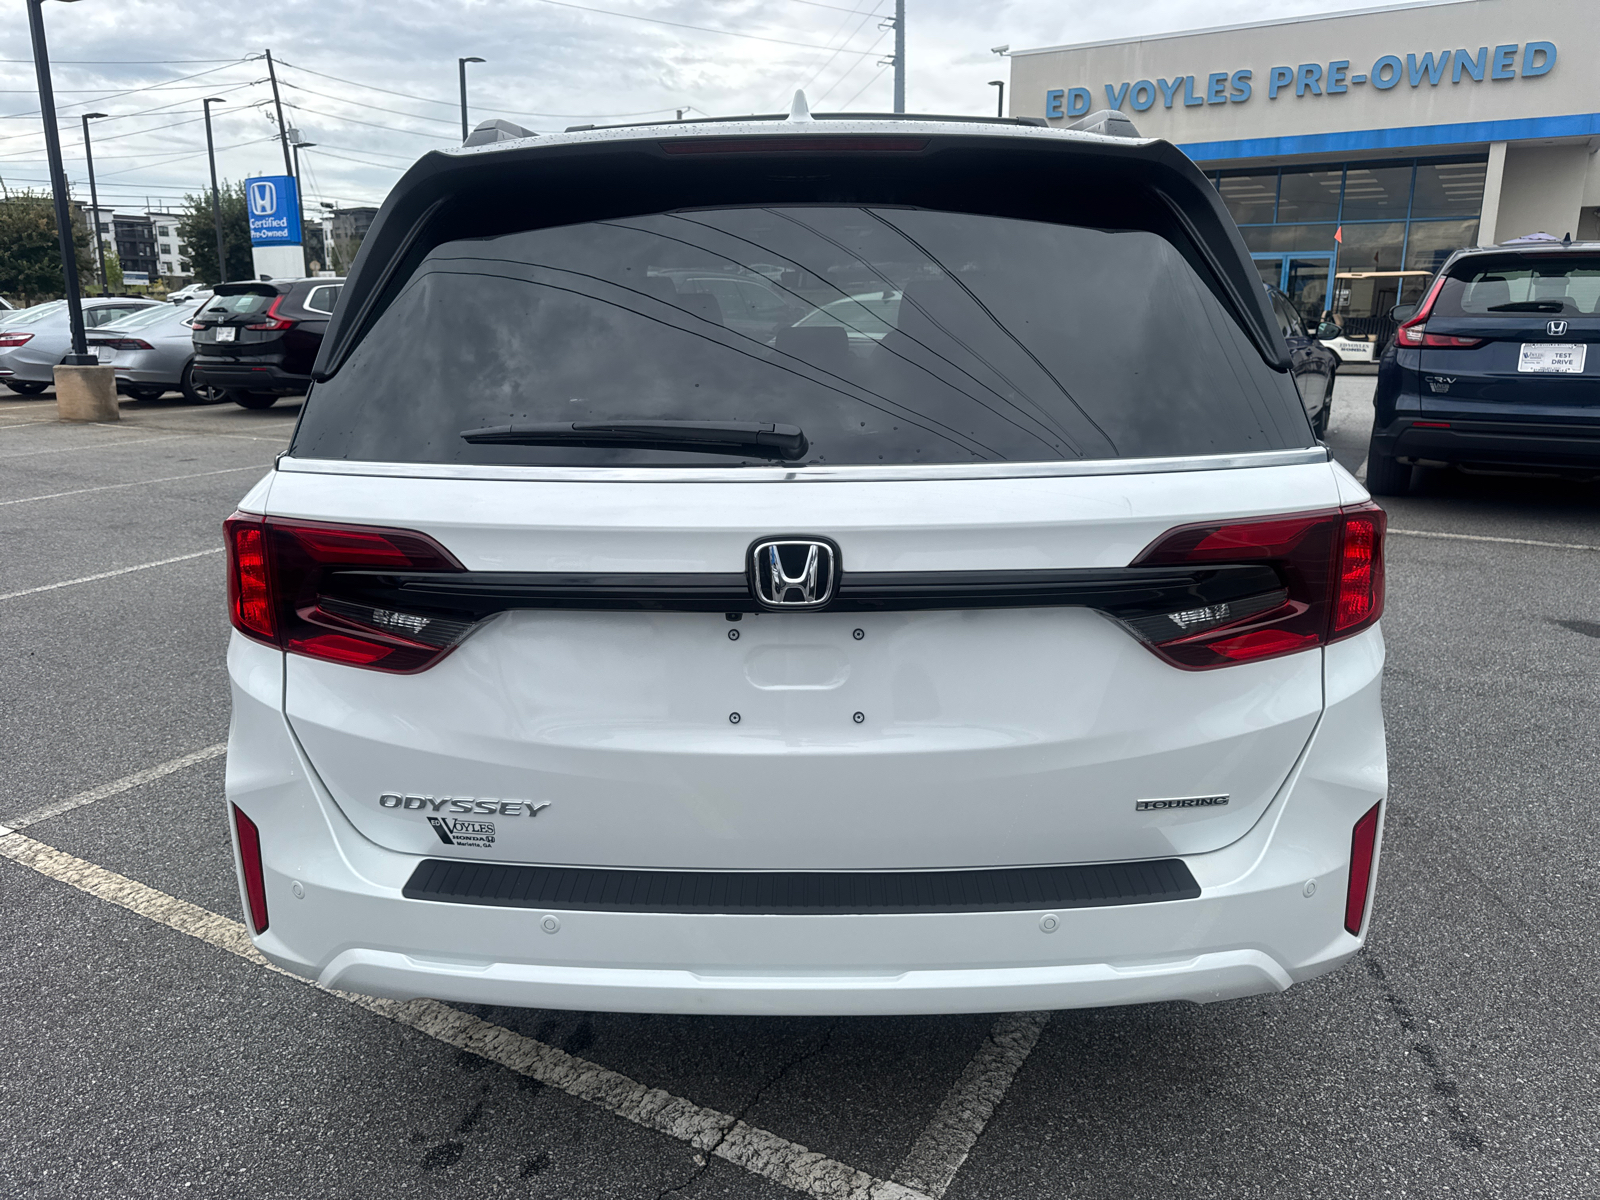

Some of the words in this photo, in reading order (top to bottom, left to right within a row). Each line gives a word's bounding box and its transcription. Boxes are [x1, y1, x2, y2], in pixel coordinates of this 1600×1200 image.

[1045, 86, 1092, 119] ED
[1104, 69, 1252, 112] VOYLES
[1268, 40, 1558, 100] PRE-OWNED
[250, 217, 287, 228] Certified
[251, 228, 288, 239] Pre-Owned
[1424, 375, 1457, 384] CR-V
[379, 792, 552, 818] ODYSSEY
[1140, 797, 1228, 809] TOURING
[440, 817, 495, 834] VOYLES
[452, 834, 486, 842] HONDA
